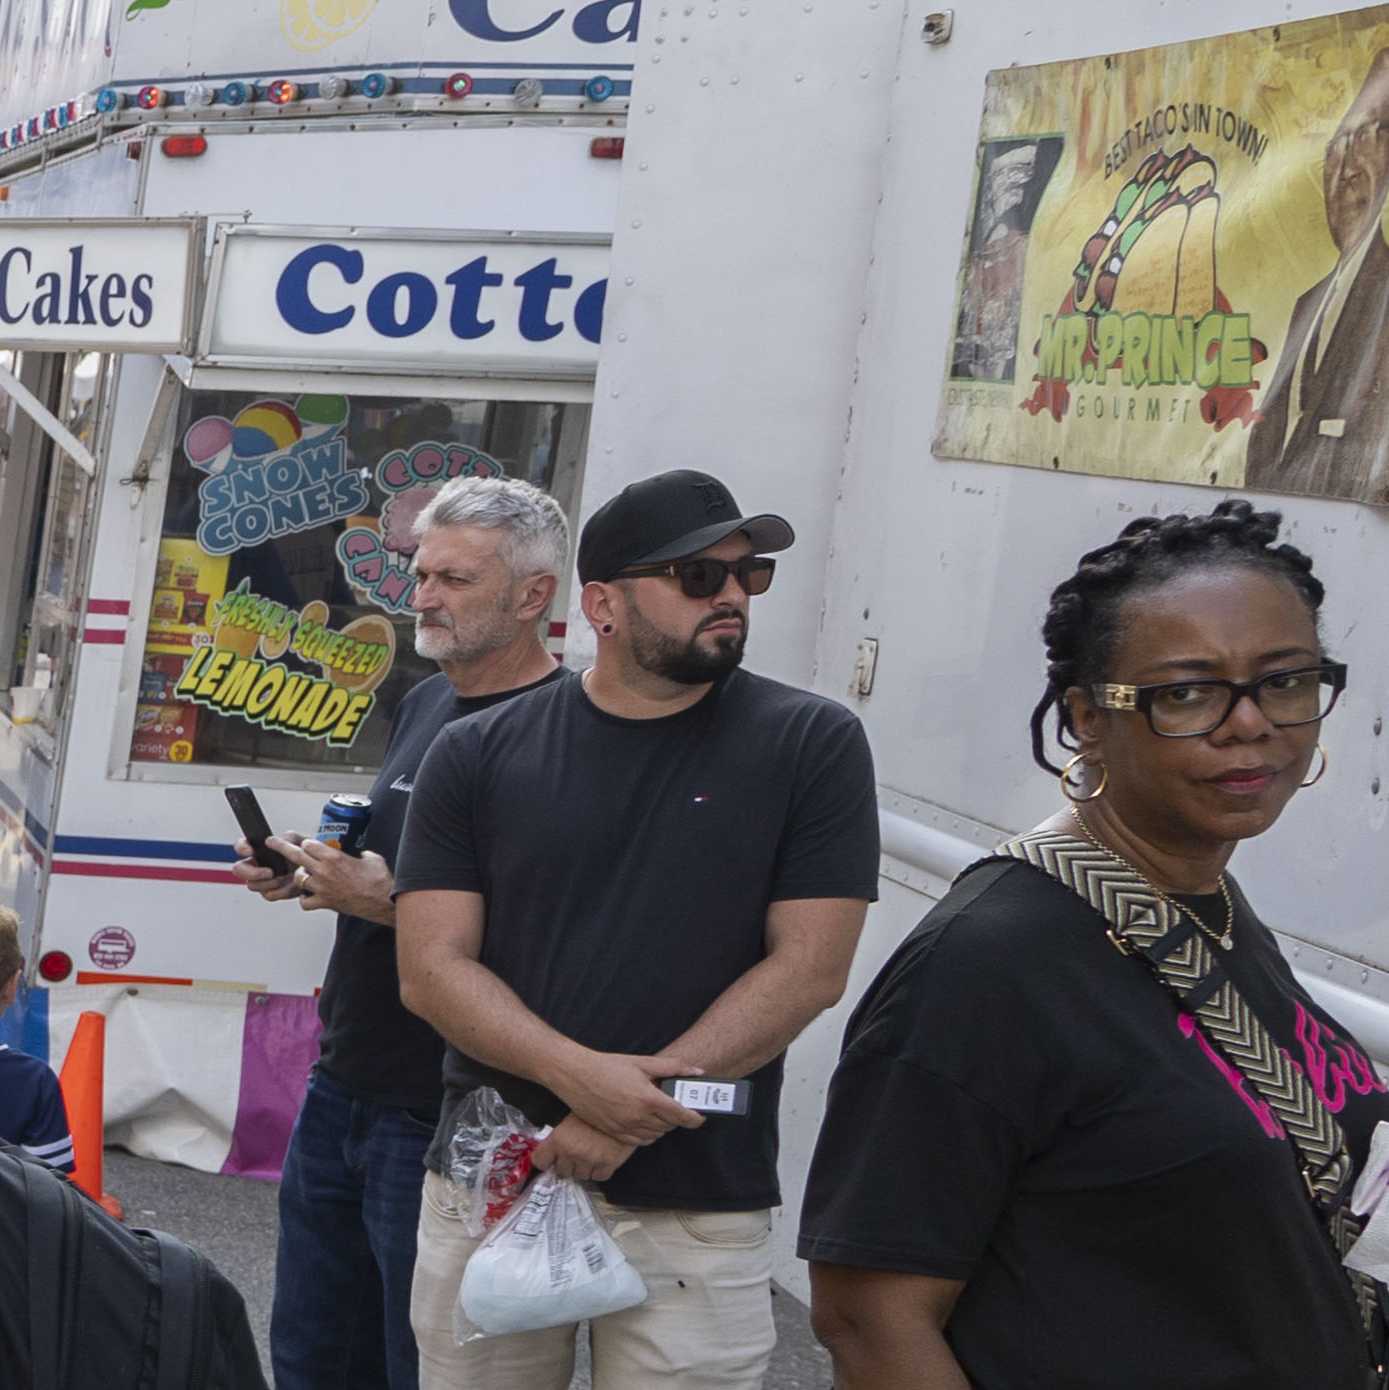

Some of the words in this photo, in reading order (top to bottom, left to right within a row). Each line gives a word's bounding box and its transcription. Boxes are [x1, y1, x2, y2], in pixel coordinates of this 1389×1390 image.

[1104, 129, 1132, 181] BEST
[1135, 103, 1189, 149] TACO'S
[1194, 103, 1211, 134] IN
[1215, 107, 1269, 167] TOWN!
[1076, 396, 1191, 423] GOURMET
[202, 440, 345, 516] SNOW
[381, 445, 501, 489] COTT
[201, 473, 369, 552] CONES
[343, 530, 418, 609] CAN
[220, 592, 300, 641] FRESHLY
[291, 621, 390, 677] SQUEEZED
[177, 646, 372, 744] LEMONADE
